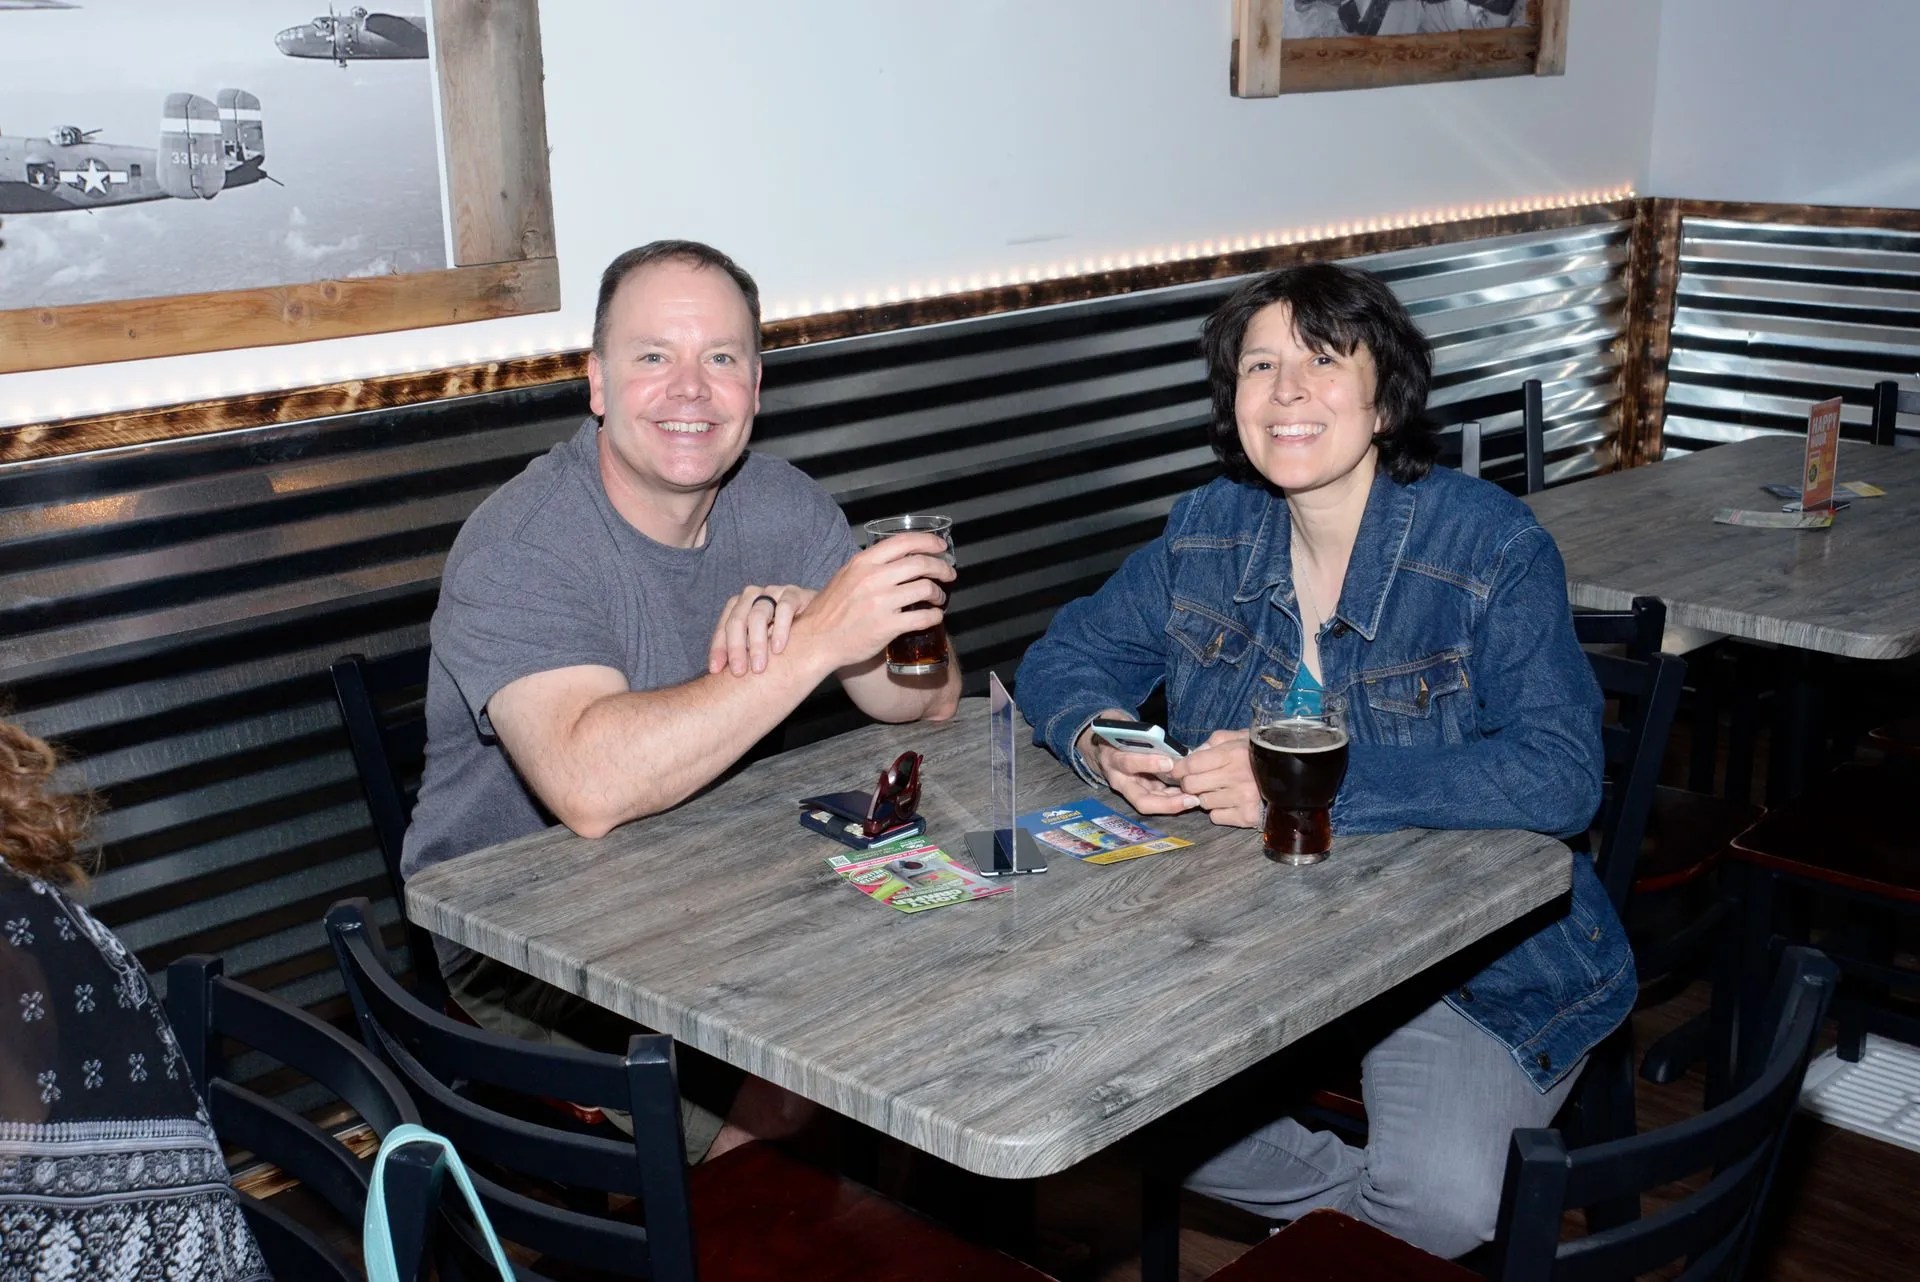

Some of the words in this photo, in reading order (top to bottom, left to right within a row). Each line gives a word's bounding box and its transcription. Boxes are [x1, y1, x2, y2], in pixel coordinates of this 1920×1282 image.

[171, 151, 218, 165] 33644
[1812, 413, 1838, 433] HAPPY
[1810, 433, 1827, 447] HOUR
